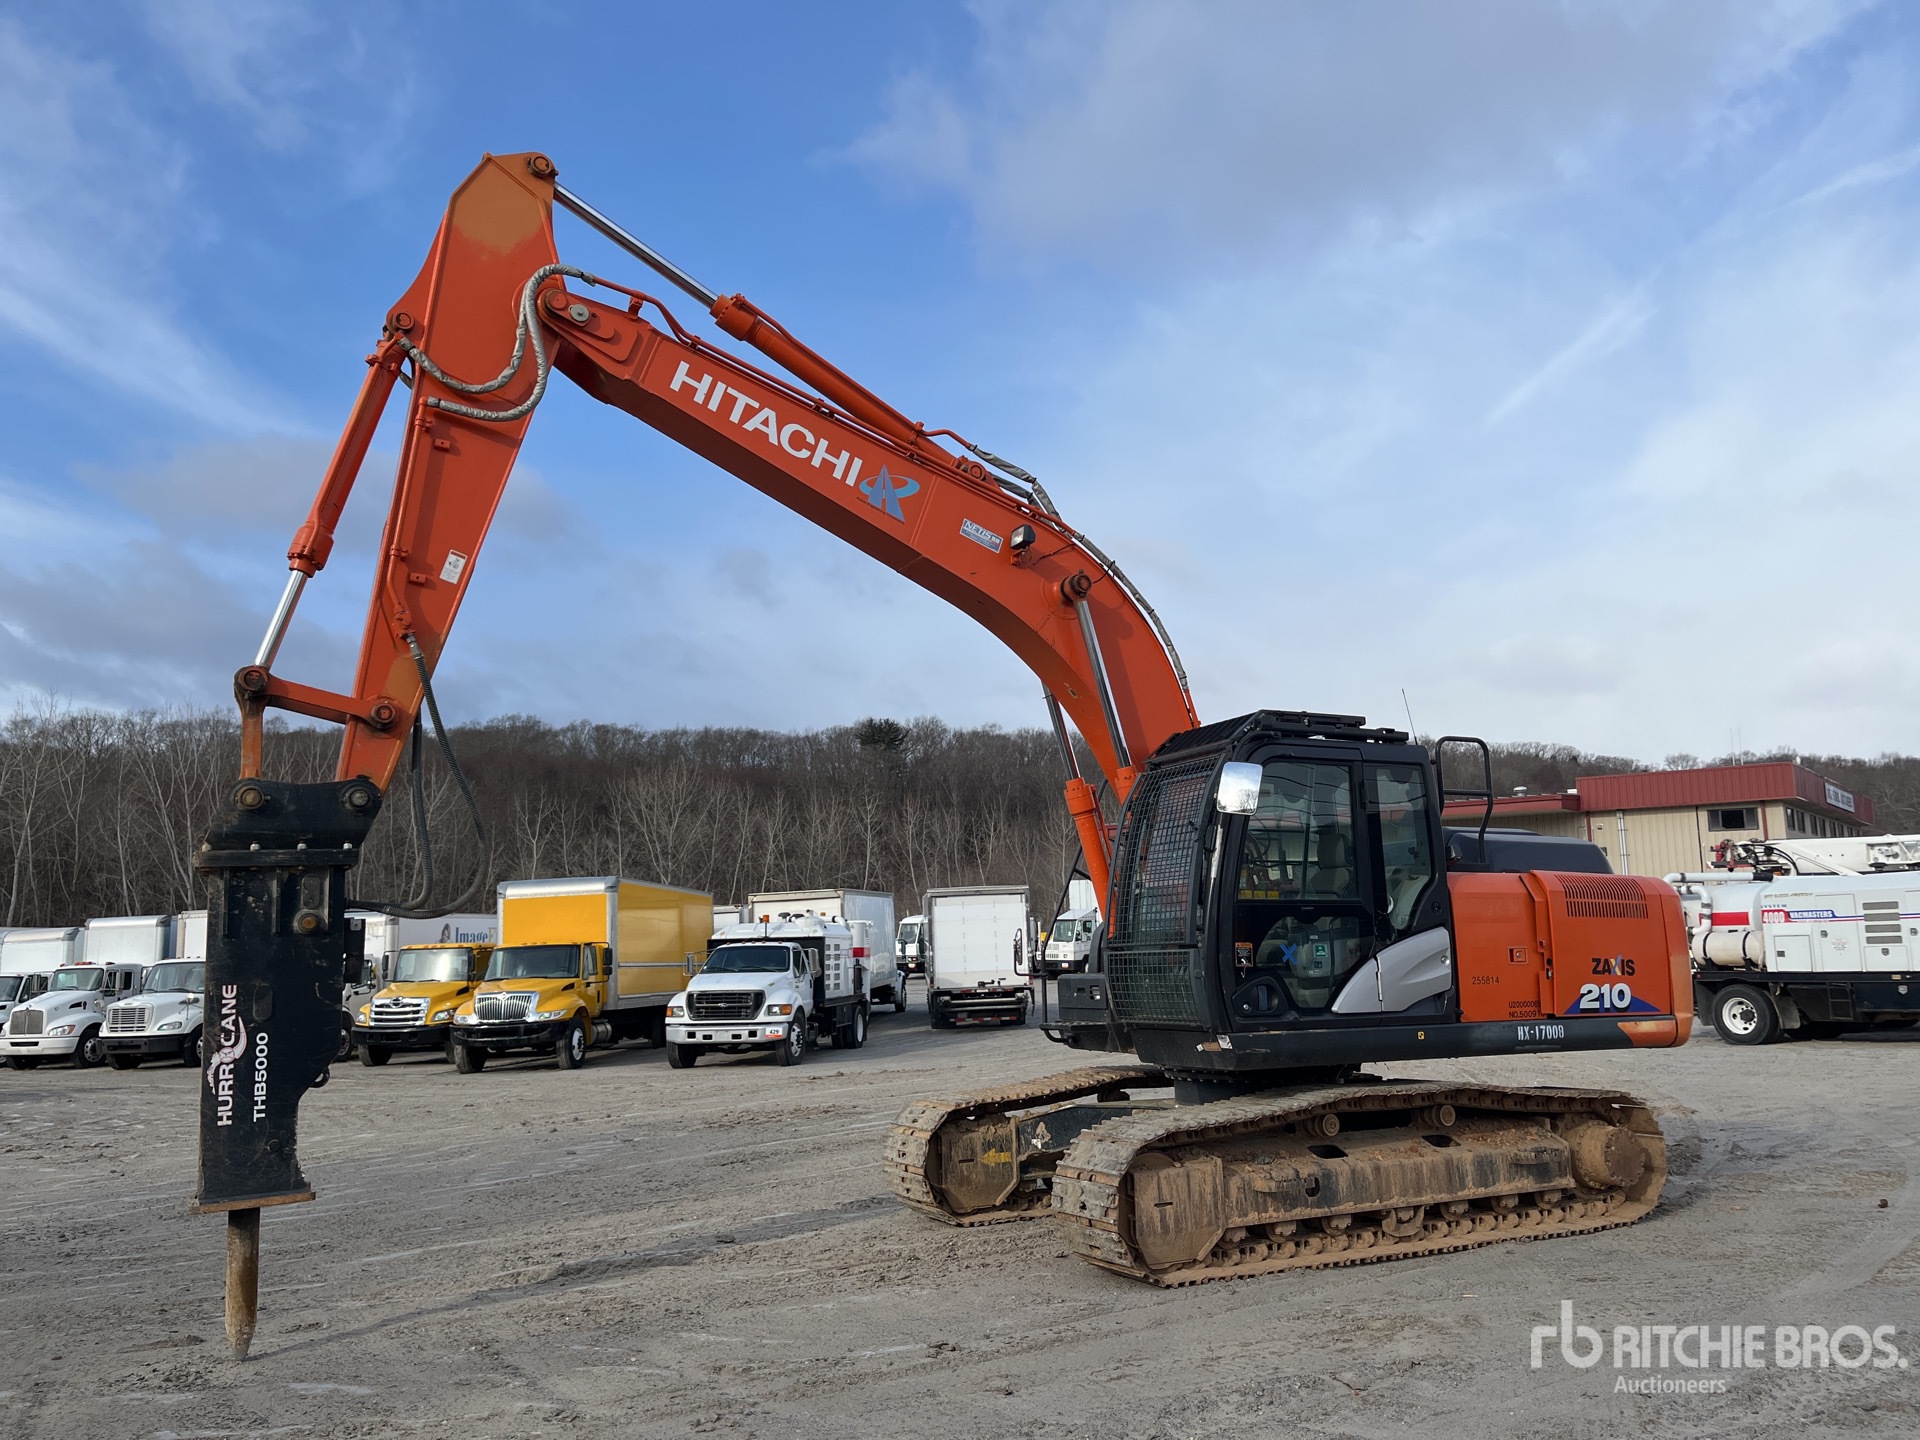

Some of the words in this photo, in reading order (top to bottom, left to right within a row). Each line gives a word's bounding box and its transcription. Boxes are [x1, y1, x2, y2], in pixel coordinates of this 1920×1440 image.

[669, 360, 863, 487] HITACHI
[1763, 911, 1785, 923] 4000
[1789, 910, 1833, 919] VACMASTERS
[1592, 954, 1636, 976] ZAXIS
[1472, 976, 1500, 985] 255814
[1580, 983, 1632, 1010] 210
[217, 984, 239, 1127] HURRICANE
[253, 1032, 269, 1122] THB5000
